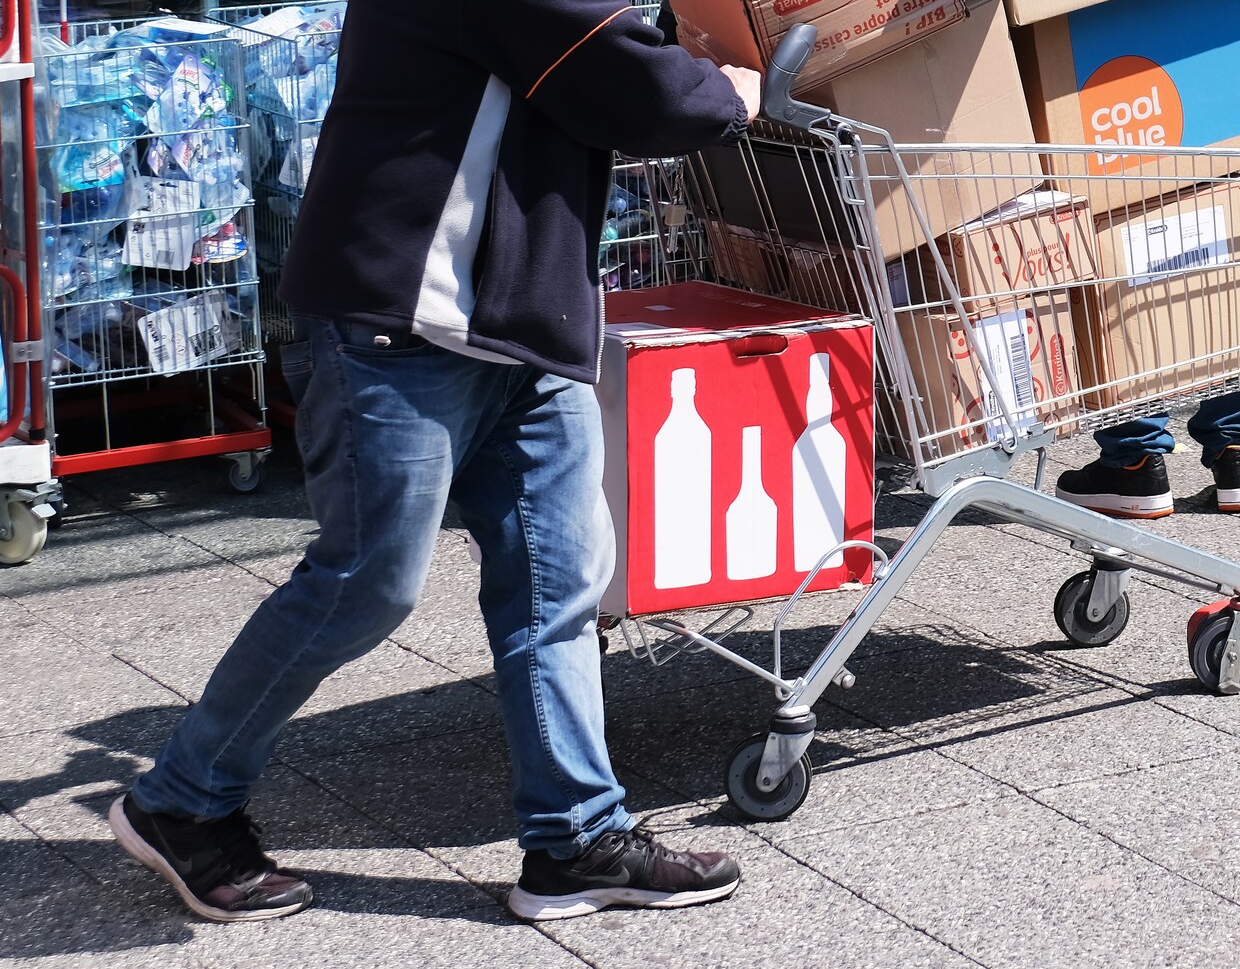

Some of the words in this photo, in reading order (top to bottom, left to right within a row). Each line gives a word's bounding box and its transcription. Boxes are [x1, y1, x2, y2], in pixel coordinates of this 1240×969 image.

[856, 3, 901, 36] propre
[916, 6, 946, 31] BIP
[811, 29, 851, 54] caiss
[1091, 86, 1162, 132] cool
[1094, 124, 1166, 166] blue
[1026, 247, 1042, 258] plus
[1043, 243, 1060, 253] pour
